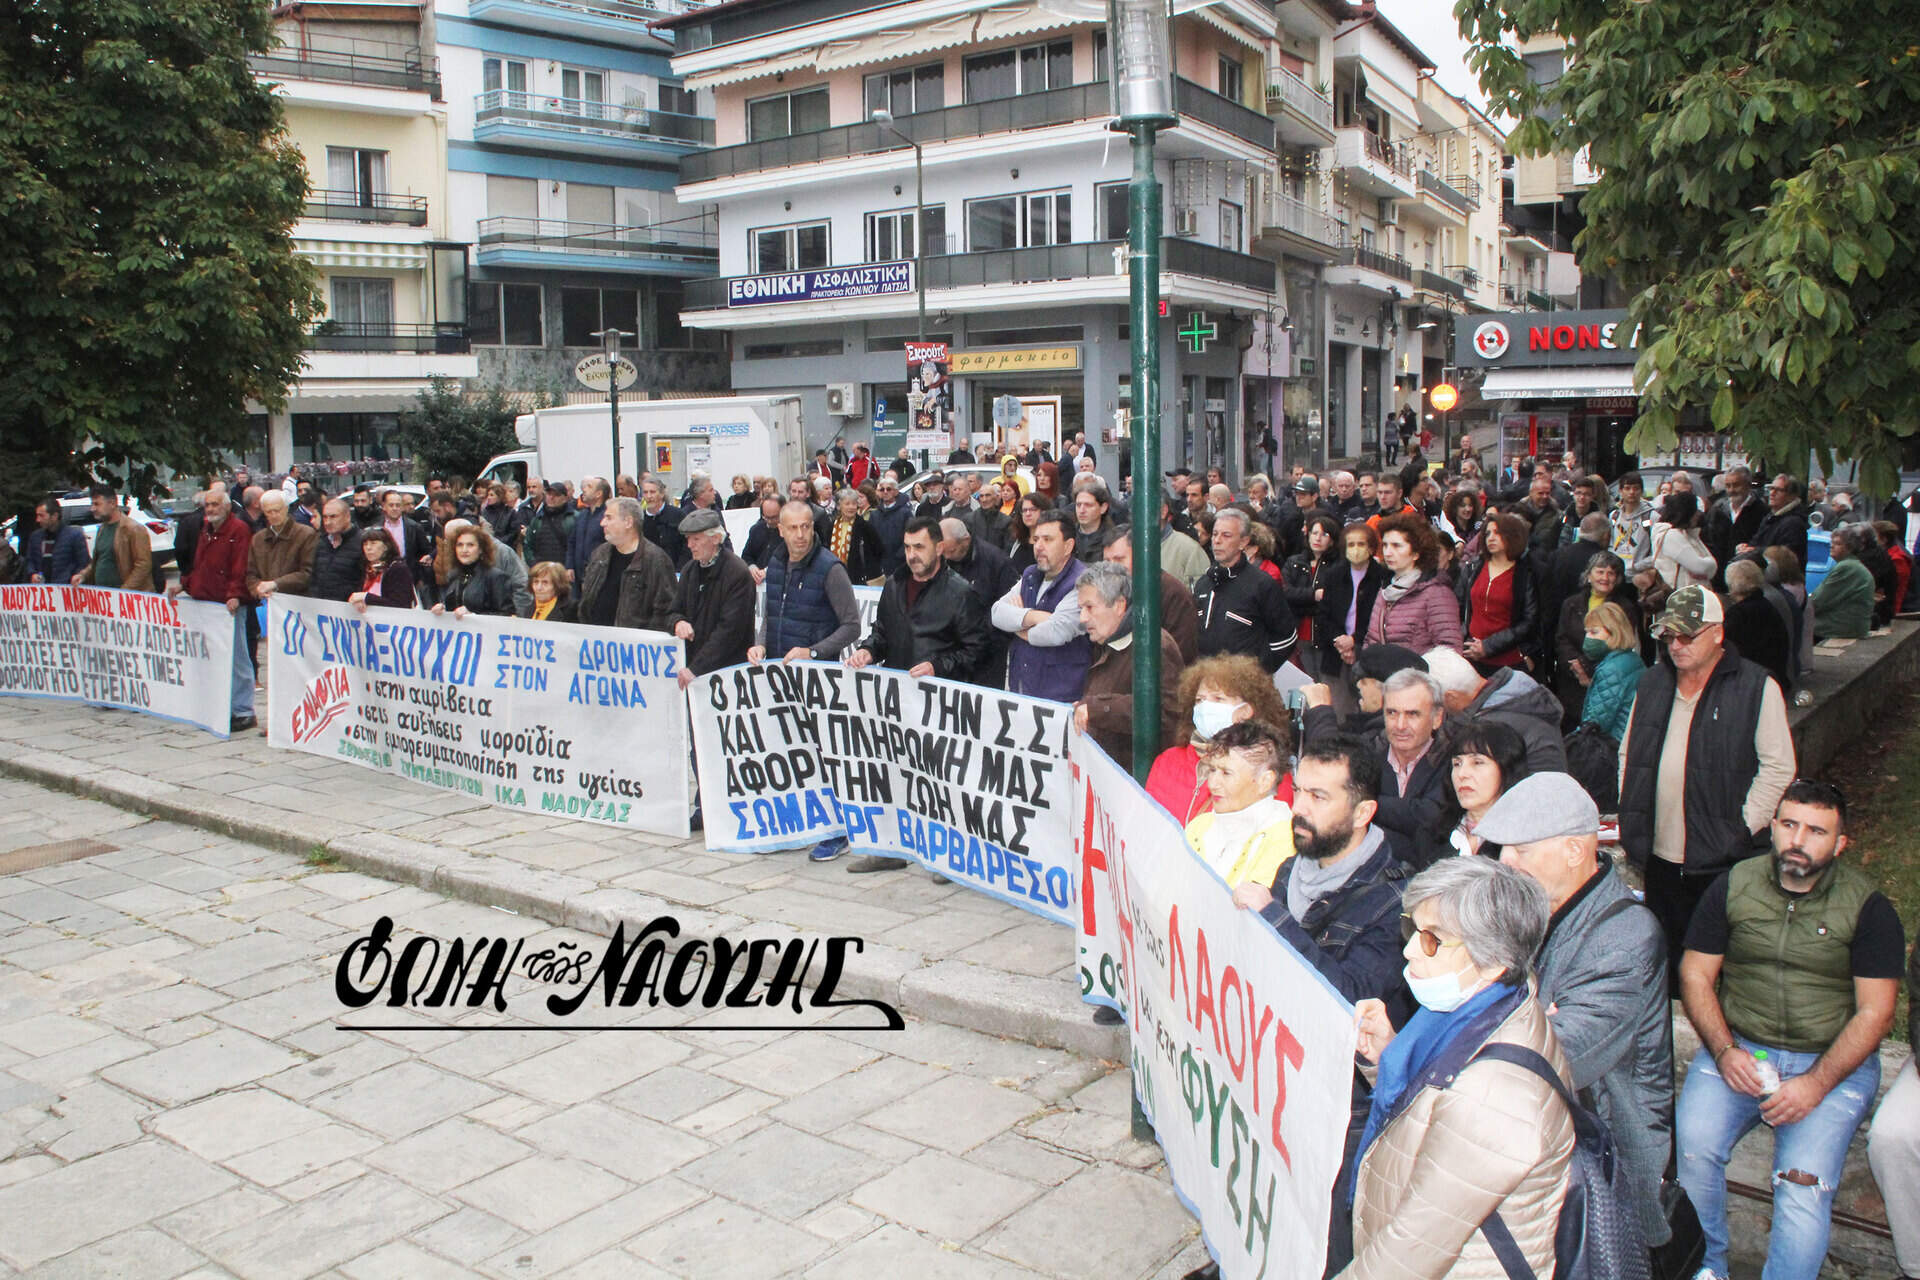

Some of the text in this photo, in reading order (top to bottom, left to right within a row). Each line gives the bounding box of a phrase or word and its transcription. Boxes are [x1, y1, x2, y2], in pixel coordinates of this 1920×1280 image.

[731, 265, 908, 300] ΕΘΝΙΚΗ ΑΣΦΑΛΙΣΤΙΚΗ
[881, 281, 909, 293] ΠΑΤΣΙΑ
[960, 350, 1070, 370] φαρμακείο
[1586, 398, 1635, 409] ΕΙΣΟΔΟΣ
[1, 586, 56, 612] ΝΑΟΥΣΑΣ
[83, 616, 108, 644] ΣΤΟ
[145, 624, 172, 653] ΑΠΟ
[173, 628, 210, 661] ΕΛΓΑ
[282, 610, 484, 688] ΟΙ ΣΥΝΤΑΞΙΟΥΧΟΙ
[497, 634, 679, 679] ΣΤΟΥΣ ΔΡΟΜΟΥΣ
[143, 652, 185, 686] ΤΙΜΕΣ
[494, 664, 648, 709] ΣΤΟΝ ΑΓΩΝΑ
[709, 674, 728, 712] Ο
[855, 671, 902, 723] ΓΙΑ
[918, 681, 983, 740] ΤΗΝ
[717, 713, 766, 757] ΚΑΙ
[828, 713, 972, 786] ΠΛΗΡΩΜΗ
[979, 747, 1054, 810] ΜΑΣ
[495, 784, 527, 807] ΙΚΑ
[541, 791, 633, 823] ΝΑΟΥΣΑΣ
[533, 766, 565, 785] της
[579, 769, 644, 800] υγείας
[823, 757, 893, 804] ΤΗΝ
[901, 770, 956, 827] ΖΩΗ
[962, 792, 1036, 856] ΜΑΣ
[1167, 903, 1305, 1177] ΛΑΟΥΣ
